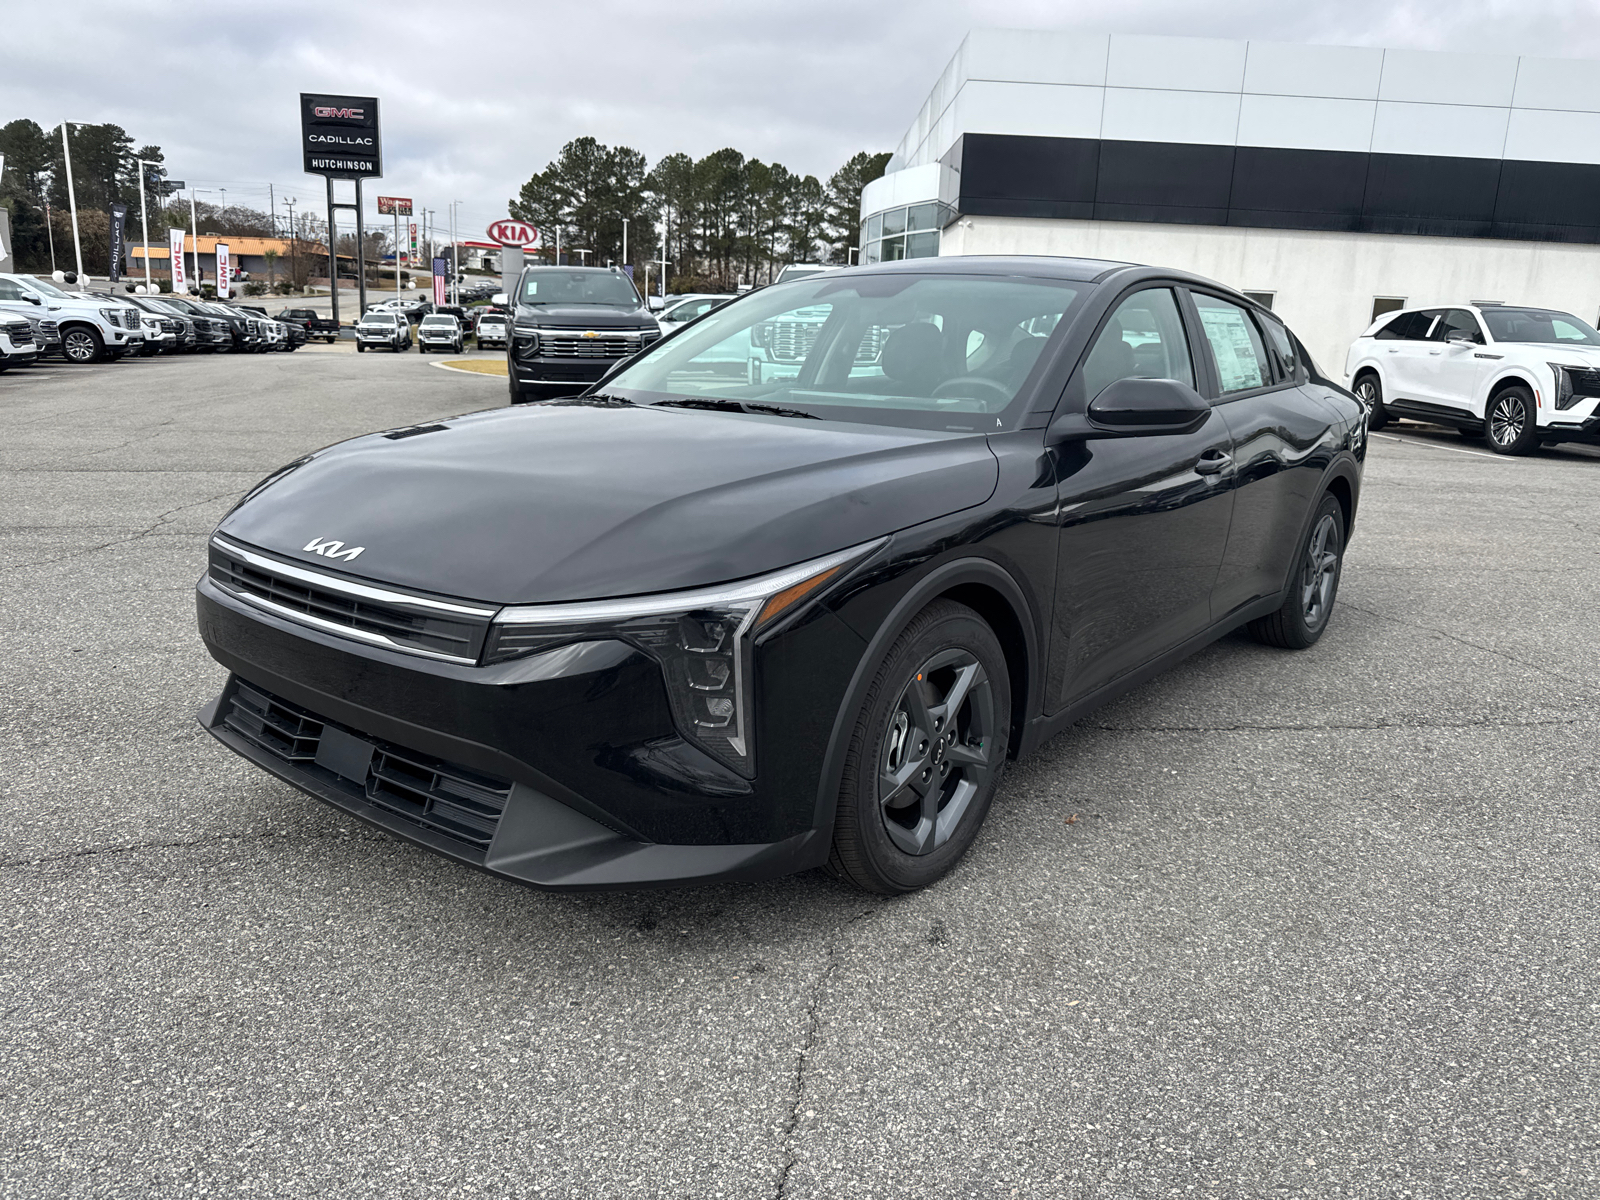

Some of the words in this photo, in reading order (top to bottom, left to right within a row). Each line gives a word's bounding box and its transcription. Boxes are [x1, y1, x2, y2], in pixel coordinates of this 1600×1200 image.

[315, 107, 364, 119] GMC
[309, 135, 373, 145] CADILLAC
[312, 158, 373, 171] HUTCHINSON
[496, 224, 530, 243] KIA
[173, 241, 183, 283] GMC
[219, 255, 227, 290] GMC
[996, 417, 1003, 427] A
[302, 536, 366, 562] KIA
